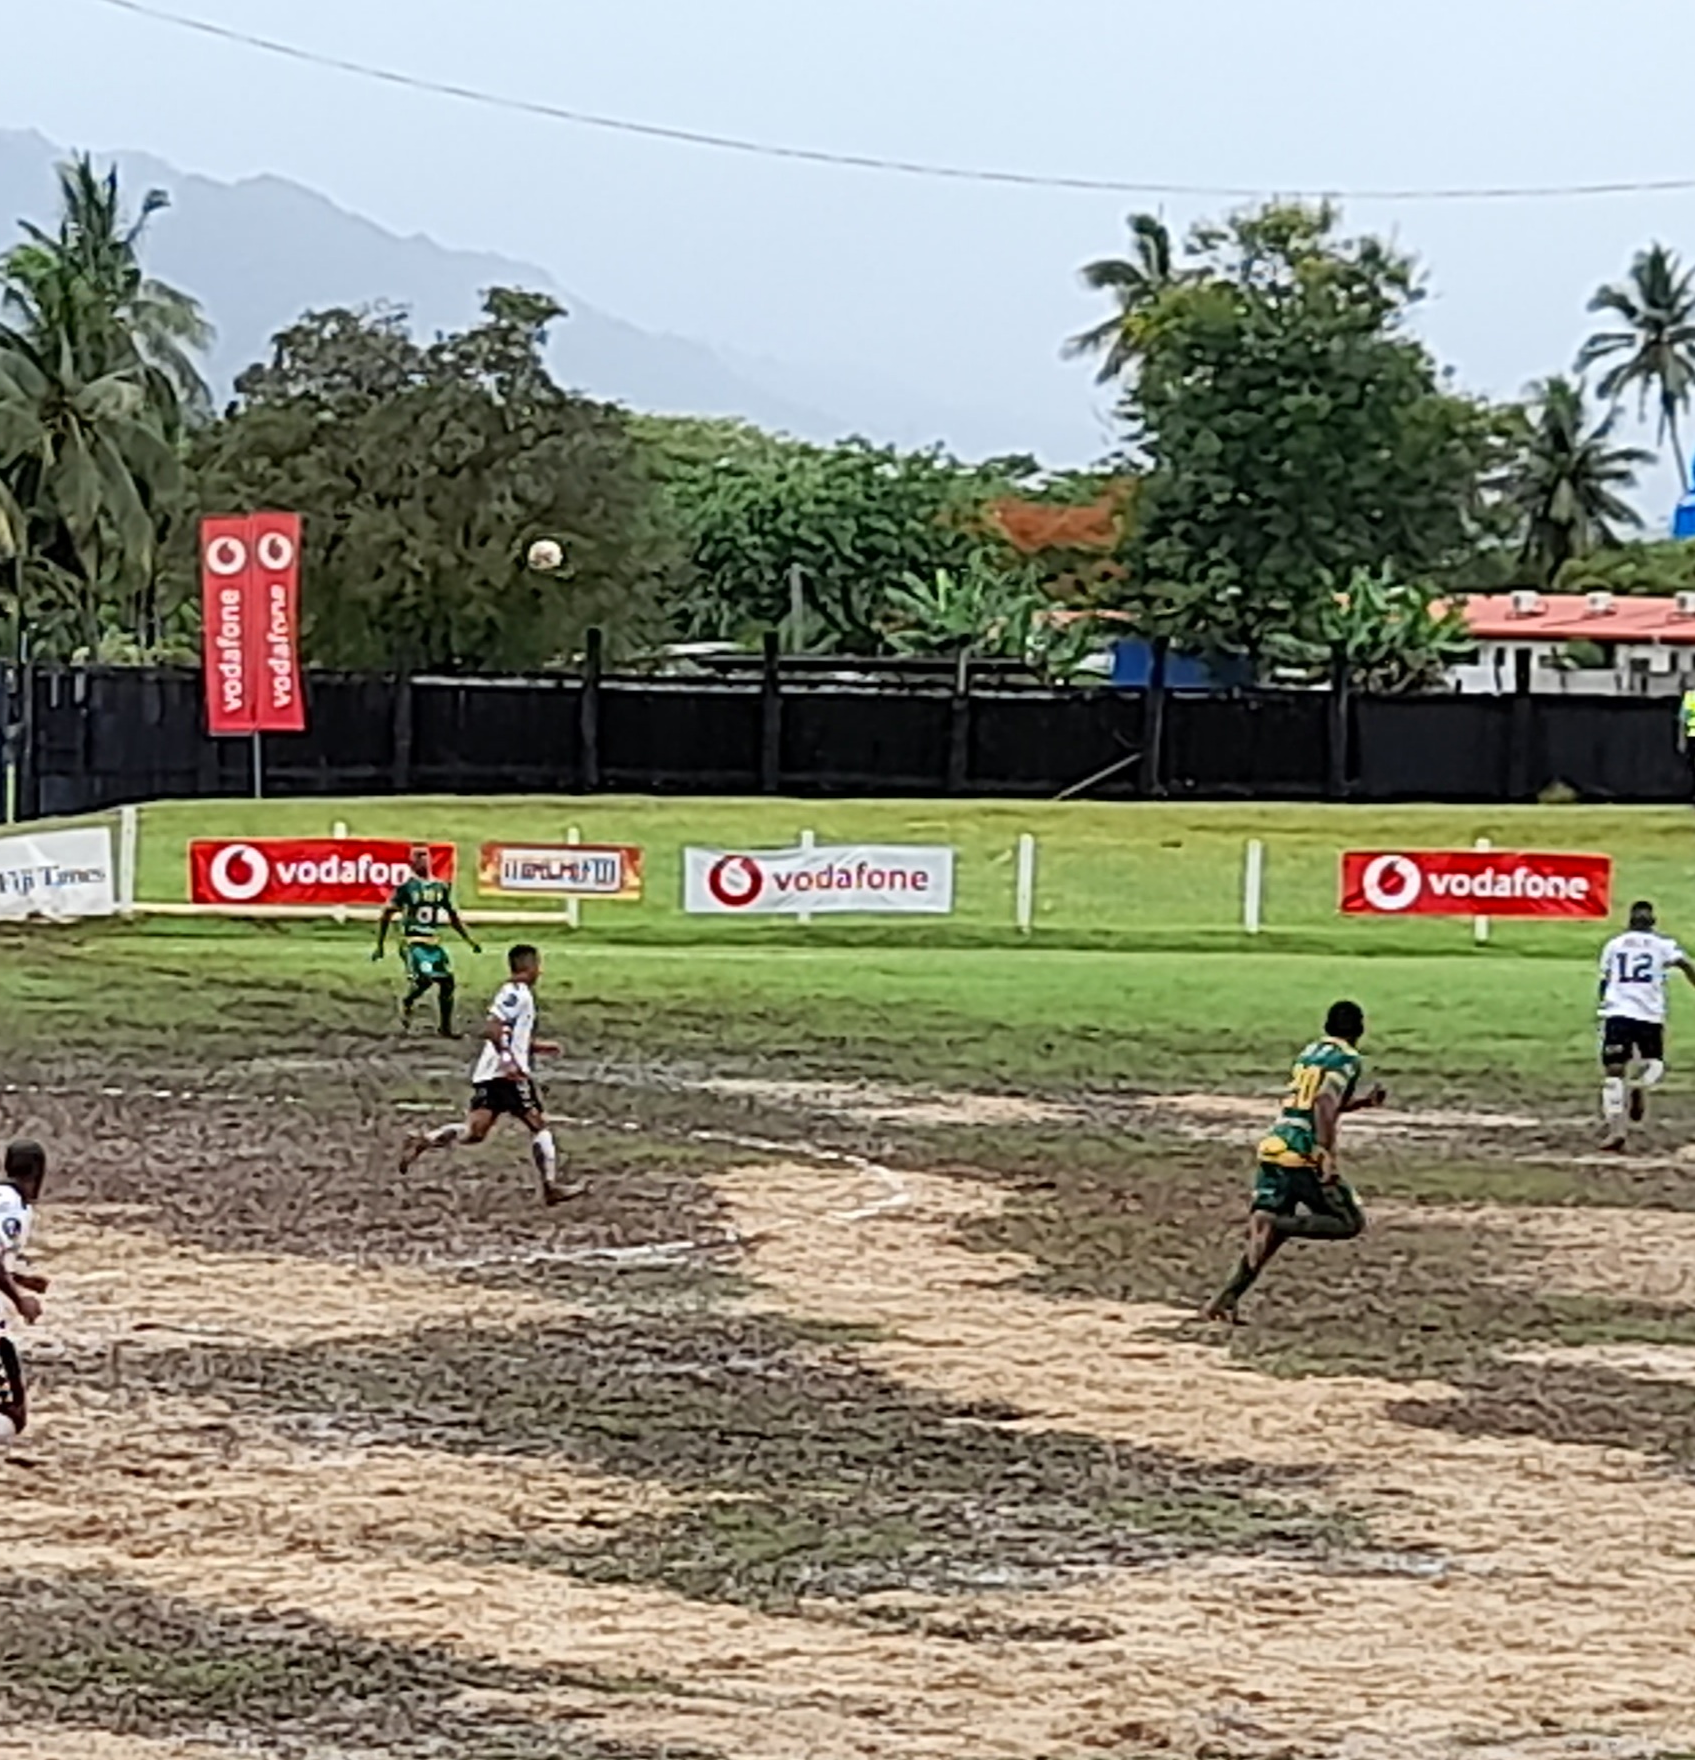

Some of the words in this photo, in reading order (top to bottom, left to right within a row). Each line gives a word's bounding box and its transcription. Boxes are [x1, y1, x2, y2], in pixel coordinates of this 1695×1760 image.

[217, 588, 243, 713] vodafone
[267, 584, 292, 708] vodafone
[275, 853, 412, 887] vodafon
[773, 860, 929, 892] vodafone
[1427, 866, 1590, 900] vodafone
[1616, 952, 1653, 983] 12
